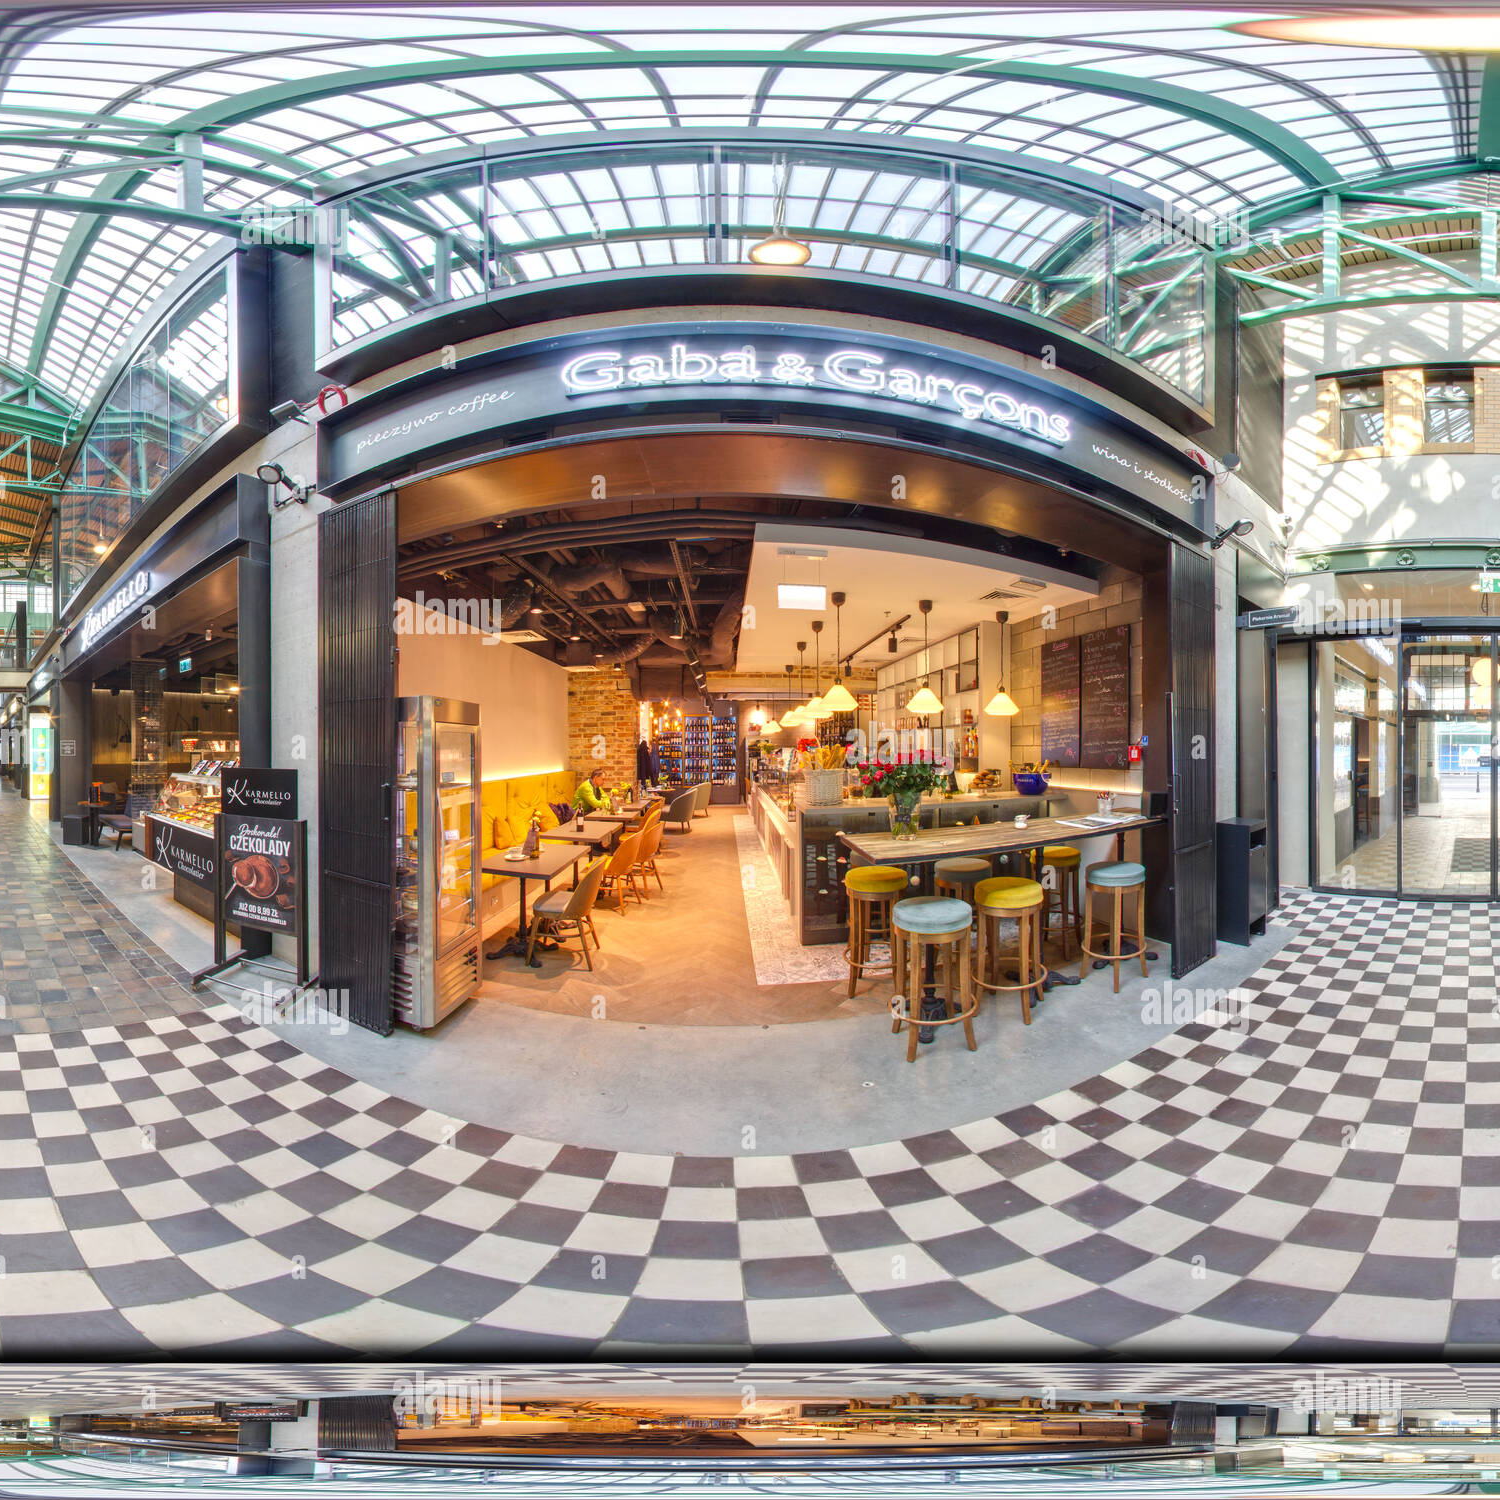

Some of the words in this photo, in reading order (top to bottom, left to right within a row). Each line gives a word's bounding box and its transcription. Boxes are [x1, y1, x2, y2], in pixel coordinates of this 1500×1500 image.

[560, 345, 762, 392] Gaba
[771, 353, 816, 383] &
[824, 350, 1071, 443] Garçons
[356, 411, 445, 454] pieczywo
[448, 389, 516, 416] coffee
[1092, 444, 1131, 467] wina
[245, 789, 291, 801] KARMELLO
[253, 797, 282, 806] Chocolatier
[229, 835, 291, 857] CZEKOLADY
[171, 845, 214, 874] KARMELLO
